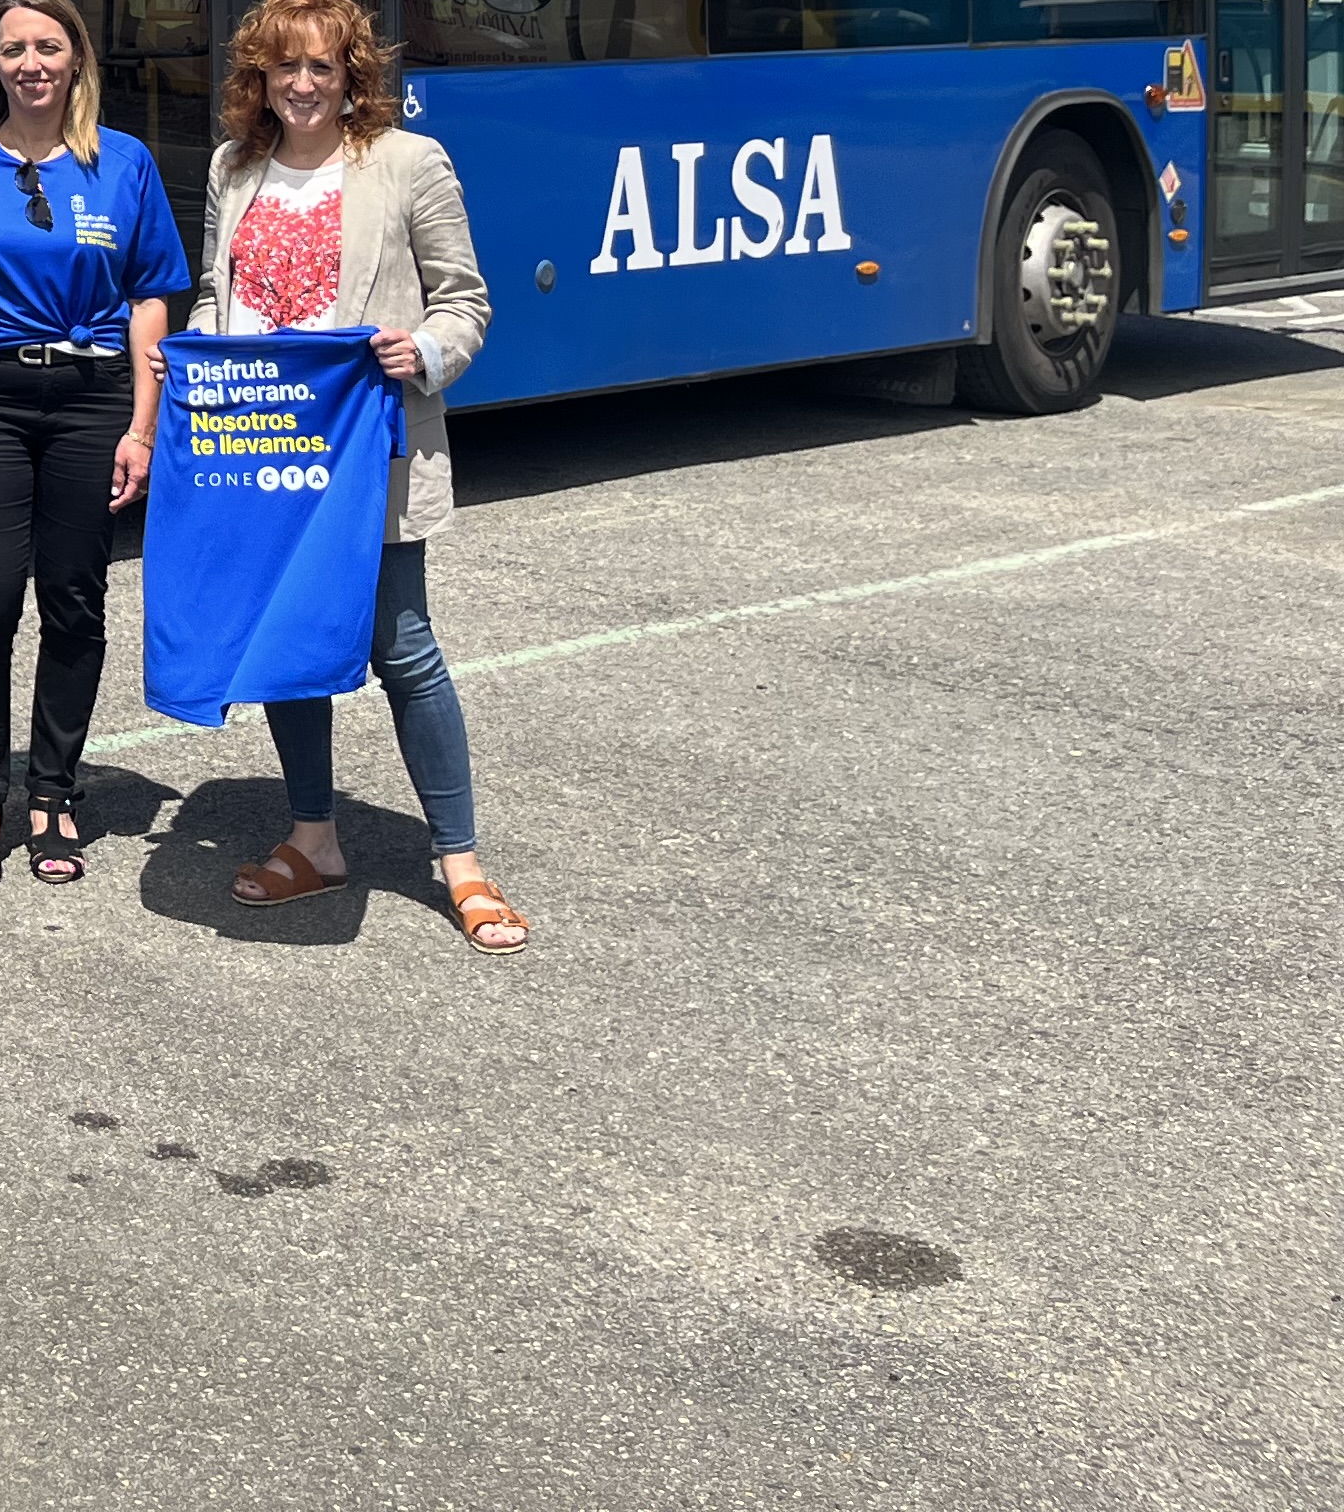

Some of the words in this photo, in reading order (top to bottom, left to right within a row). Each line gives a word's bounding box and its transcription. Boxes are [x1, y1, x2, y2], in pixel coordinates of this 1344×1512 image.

[589, 134, 852, 274] ALSA
[187, 359, 279, 384] Disfruta
[187, 385, 224, 406] del
[228, 383, 316, 402] verano.
[191, 411, 297, 432] Nosotros
[191, 436, 214, 455] te
[220, 434, 331, 455] llevamos.
[194, 464, 330, 491] CONECTA
